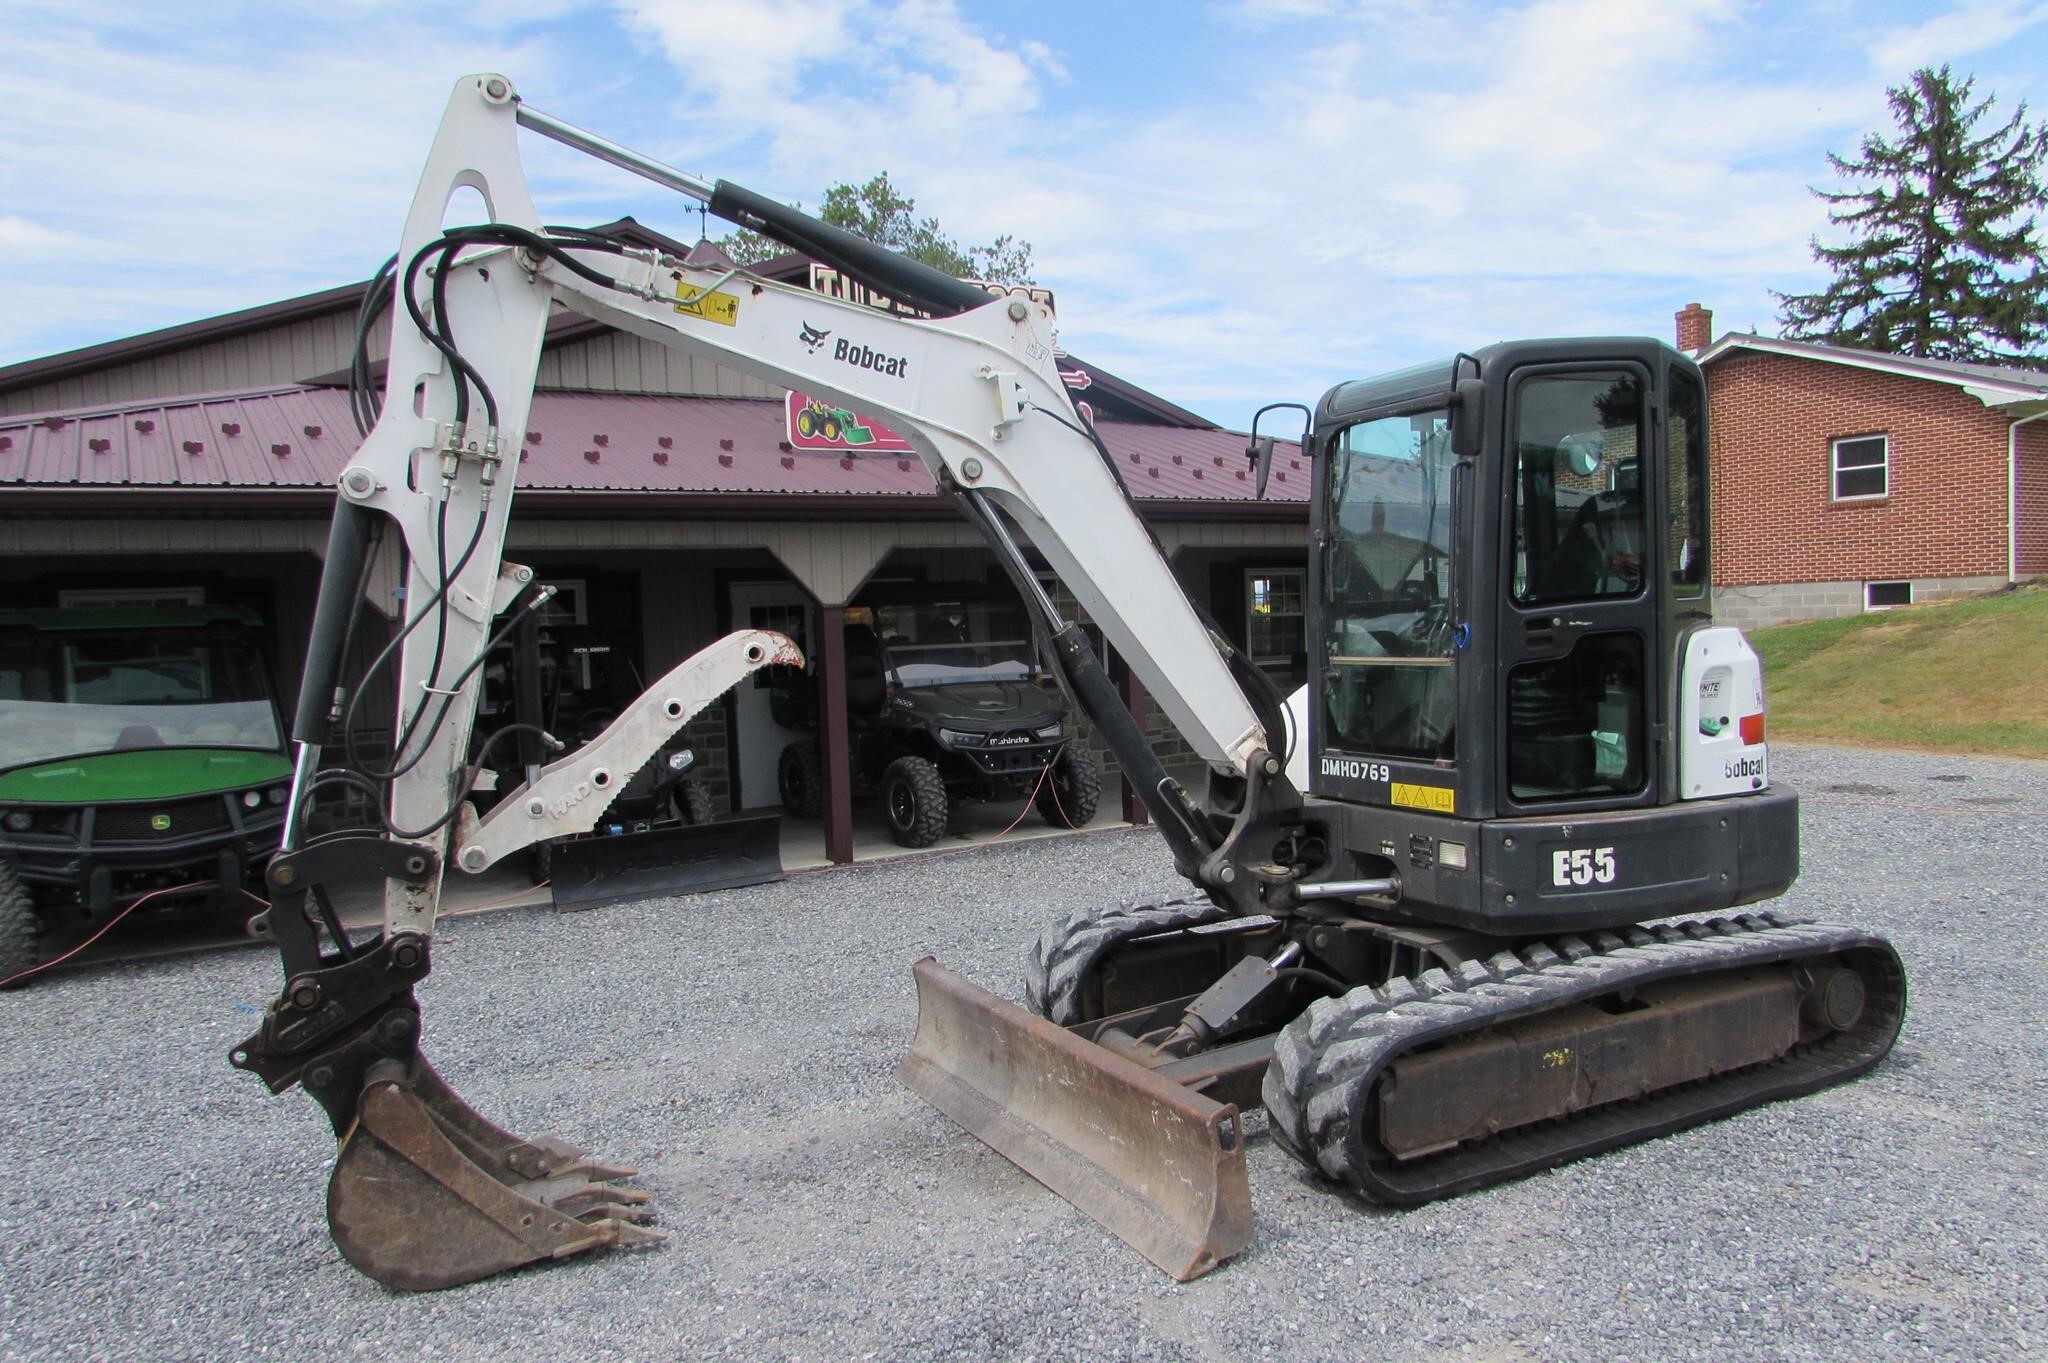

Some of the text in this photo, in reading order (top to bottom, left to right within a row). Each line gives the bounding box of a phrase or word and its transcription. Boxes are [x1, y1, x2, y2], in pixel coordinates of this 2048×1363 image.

[834, 338, 907, 379] Bobcat
[1700, 682, 1720, 693] HITE
[1321, 758, 1389, 782] DMH0769
[1552, 847, 1616, 887] E55
